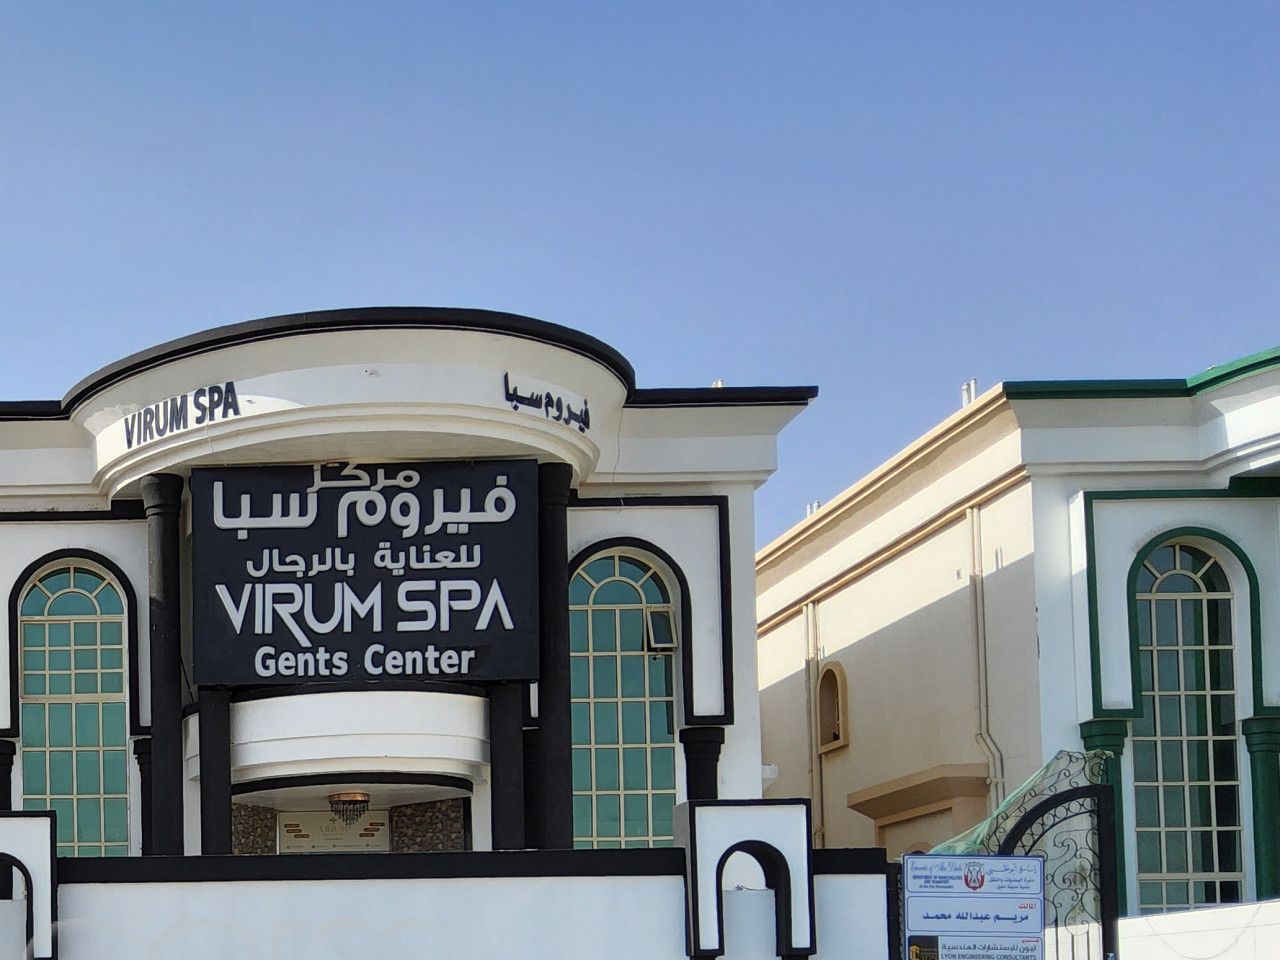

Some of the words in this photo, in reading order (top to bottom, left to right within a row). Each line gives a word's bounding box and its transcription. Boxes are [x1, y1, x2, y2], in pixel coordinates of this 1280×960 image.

[124, 394, 188, 449] VIRUM
[194, 381, 241, 425] SPA
[307, 461, 420, 492] مركز
[213, 481, 318, 540] سبا
[337, 476, 516, 538] فيروم
[246, 547, 355, 578] بالرجال
[373, 541, 481, 576] للعناية
[215, 581, 382, 648] VIRUM
[396, 579, 515, 632] SPA
[254, 646, 349, 677] Gents
[364, 643, 476, 676] Center
[923, 912, 951, 920] محمد
